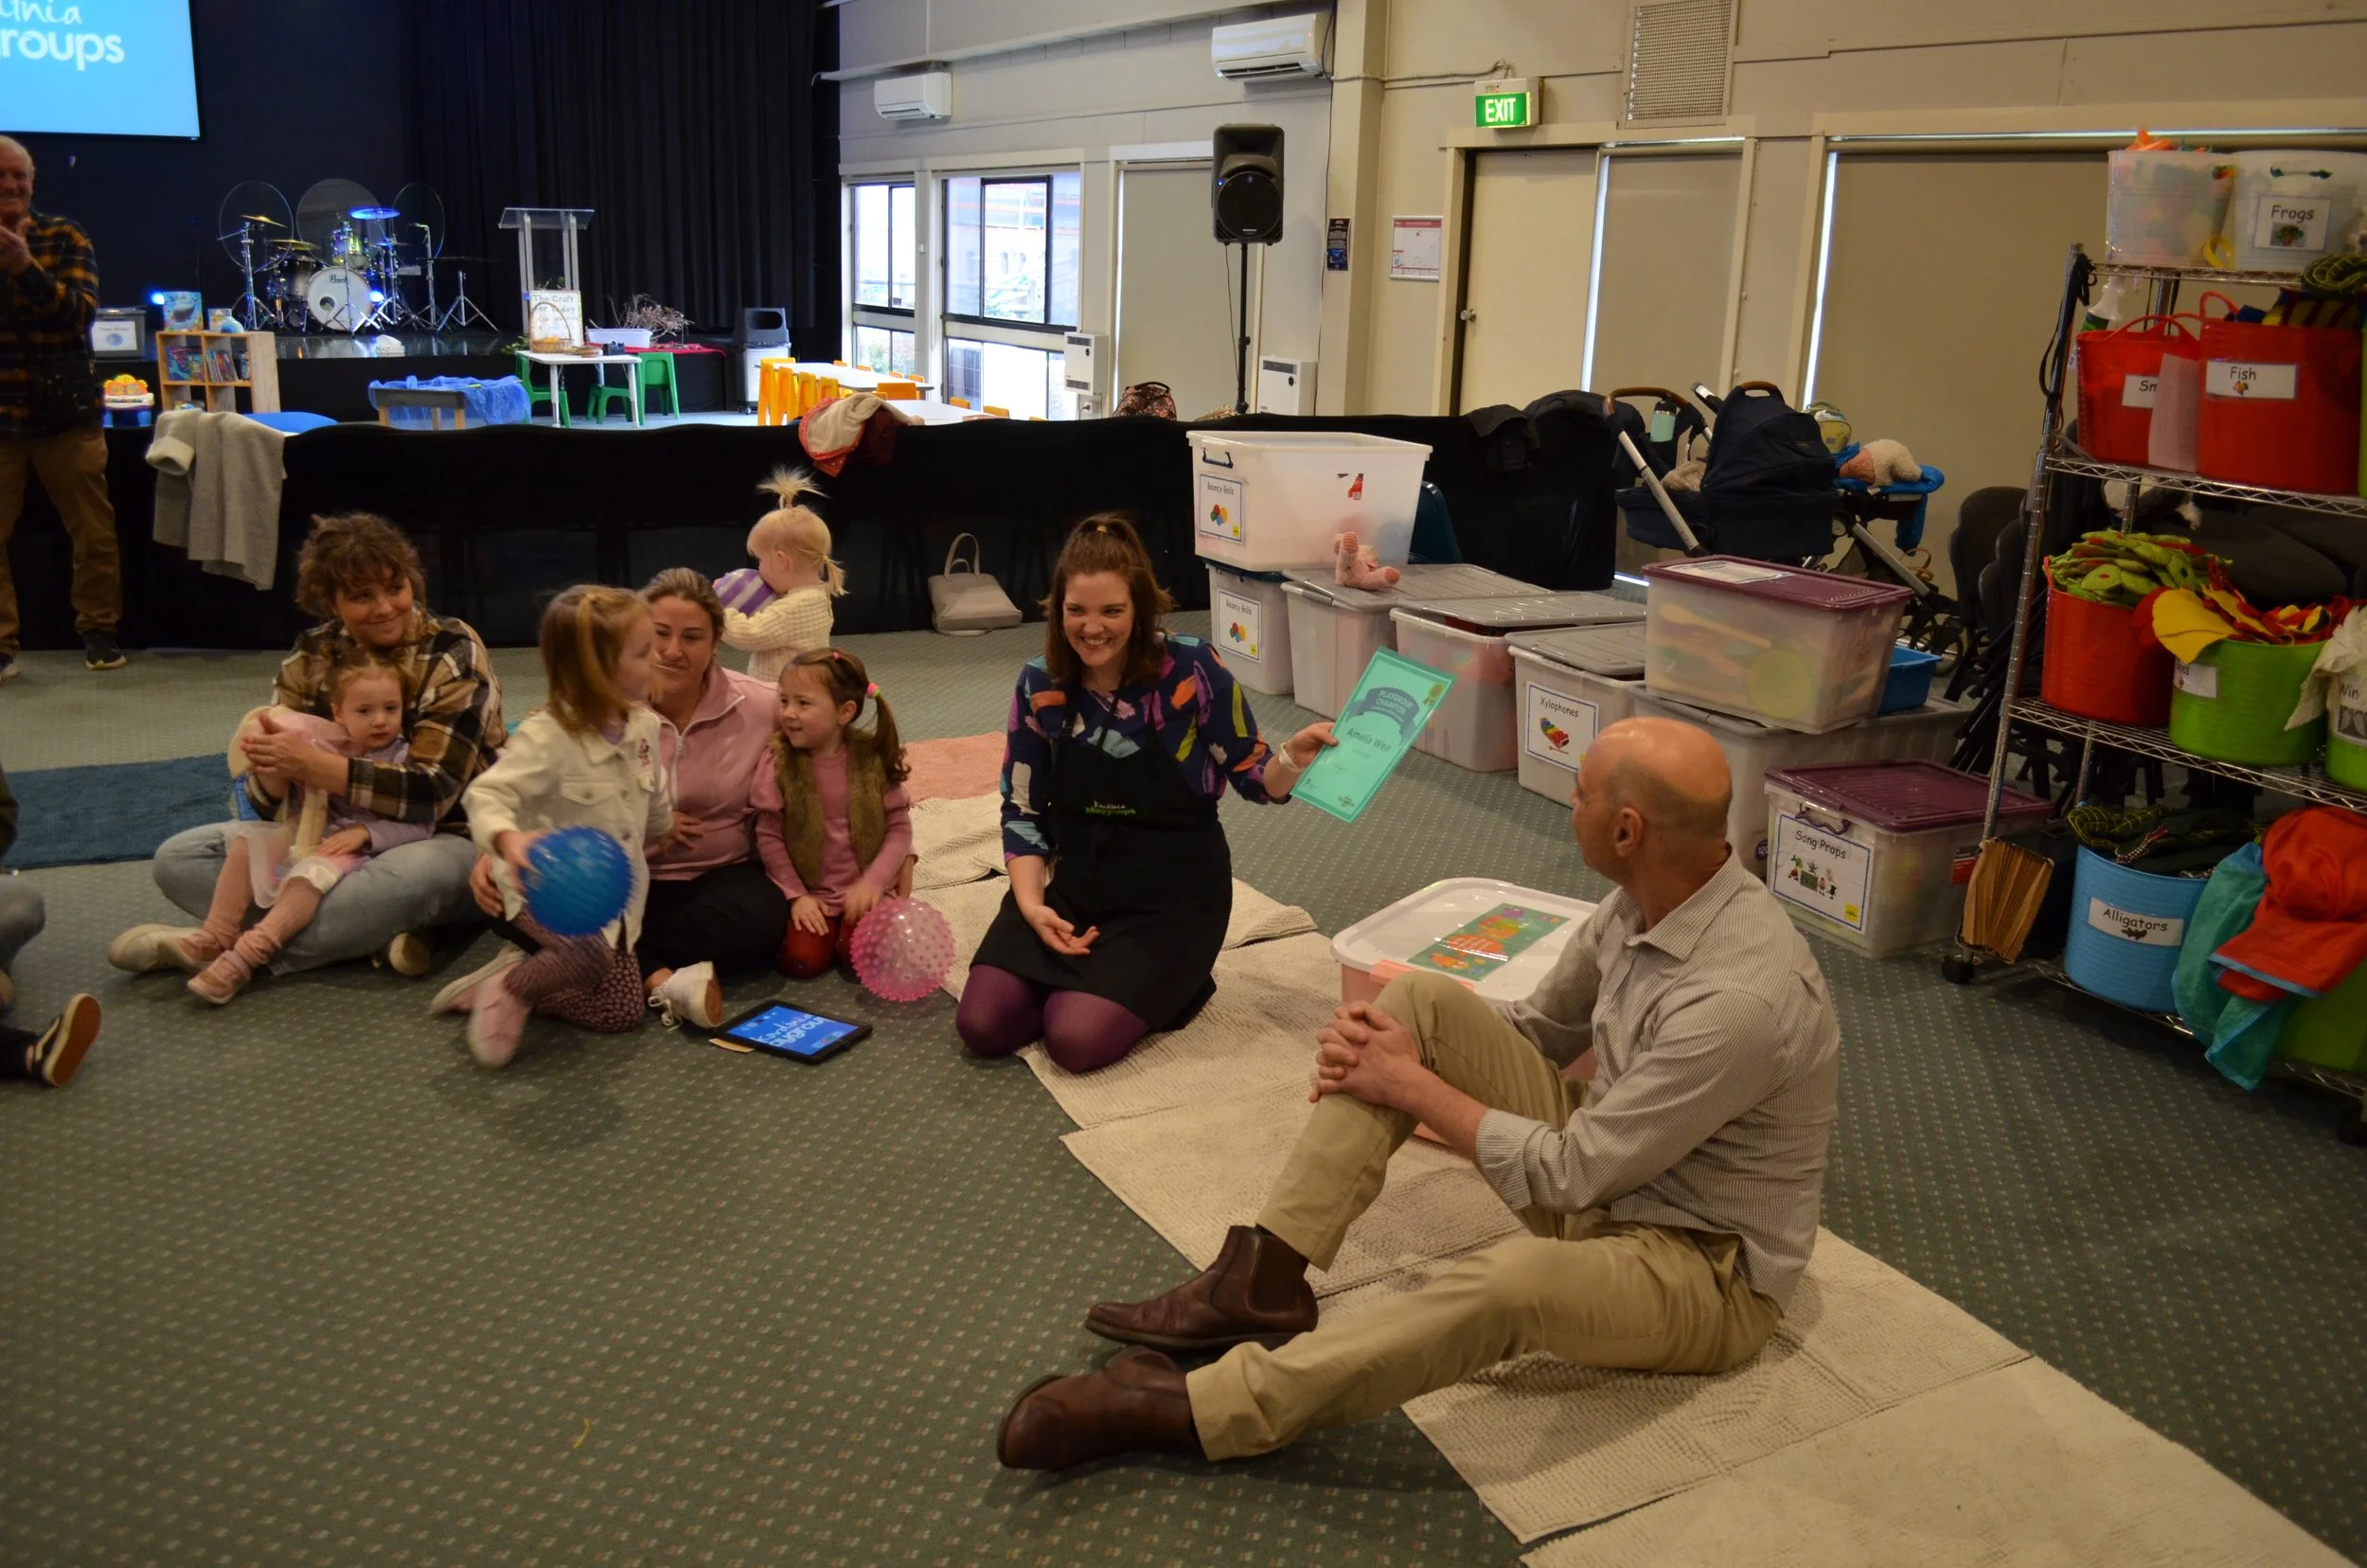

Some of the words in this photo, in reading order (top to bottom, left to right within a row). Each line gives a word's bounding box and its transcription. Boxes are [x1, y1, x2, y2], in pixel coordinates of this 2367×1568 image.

[0, 28, 126, 72] roups
[1485, 98, 1516, 123] EXIT
[2270, 204, 2315, 223] Frogs
[2230, 366, 2256, 381] Fish
[1206, 481, 1222, 494] Bouncy
[1379, 689, 1414, 708] PLAYGROUP
[2340, 682, 2359, 701] Win
[1376, 698, 1407, 715] CHAMPION
[1539, 696, 1579, 718] Xylophones
[1795, 830, 1817, 850] Song
[1819, 839, 1846, 860] Props
[2103, 908, 2168, 932] Alligators
